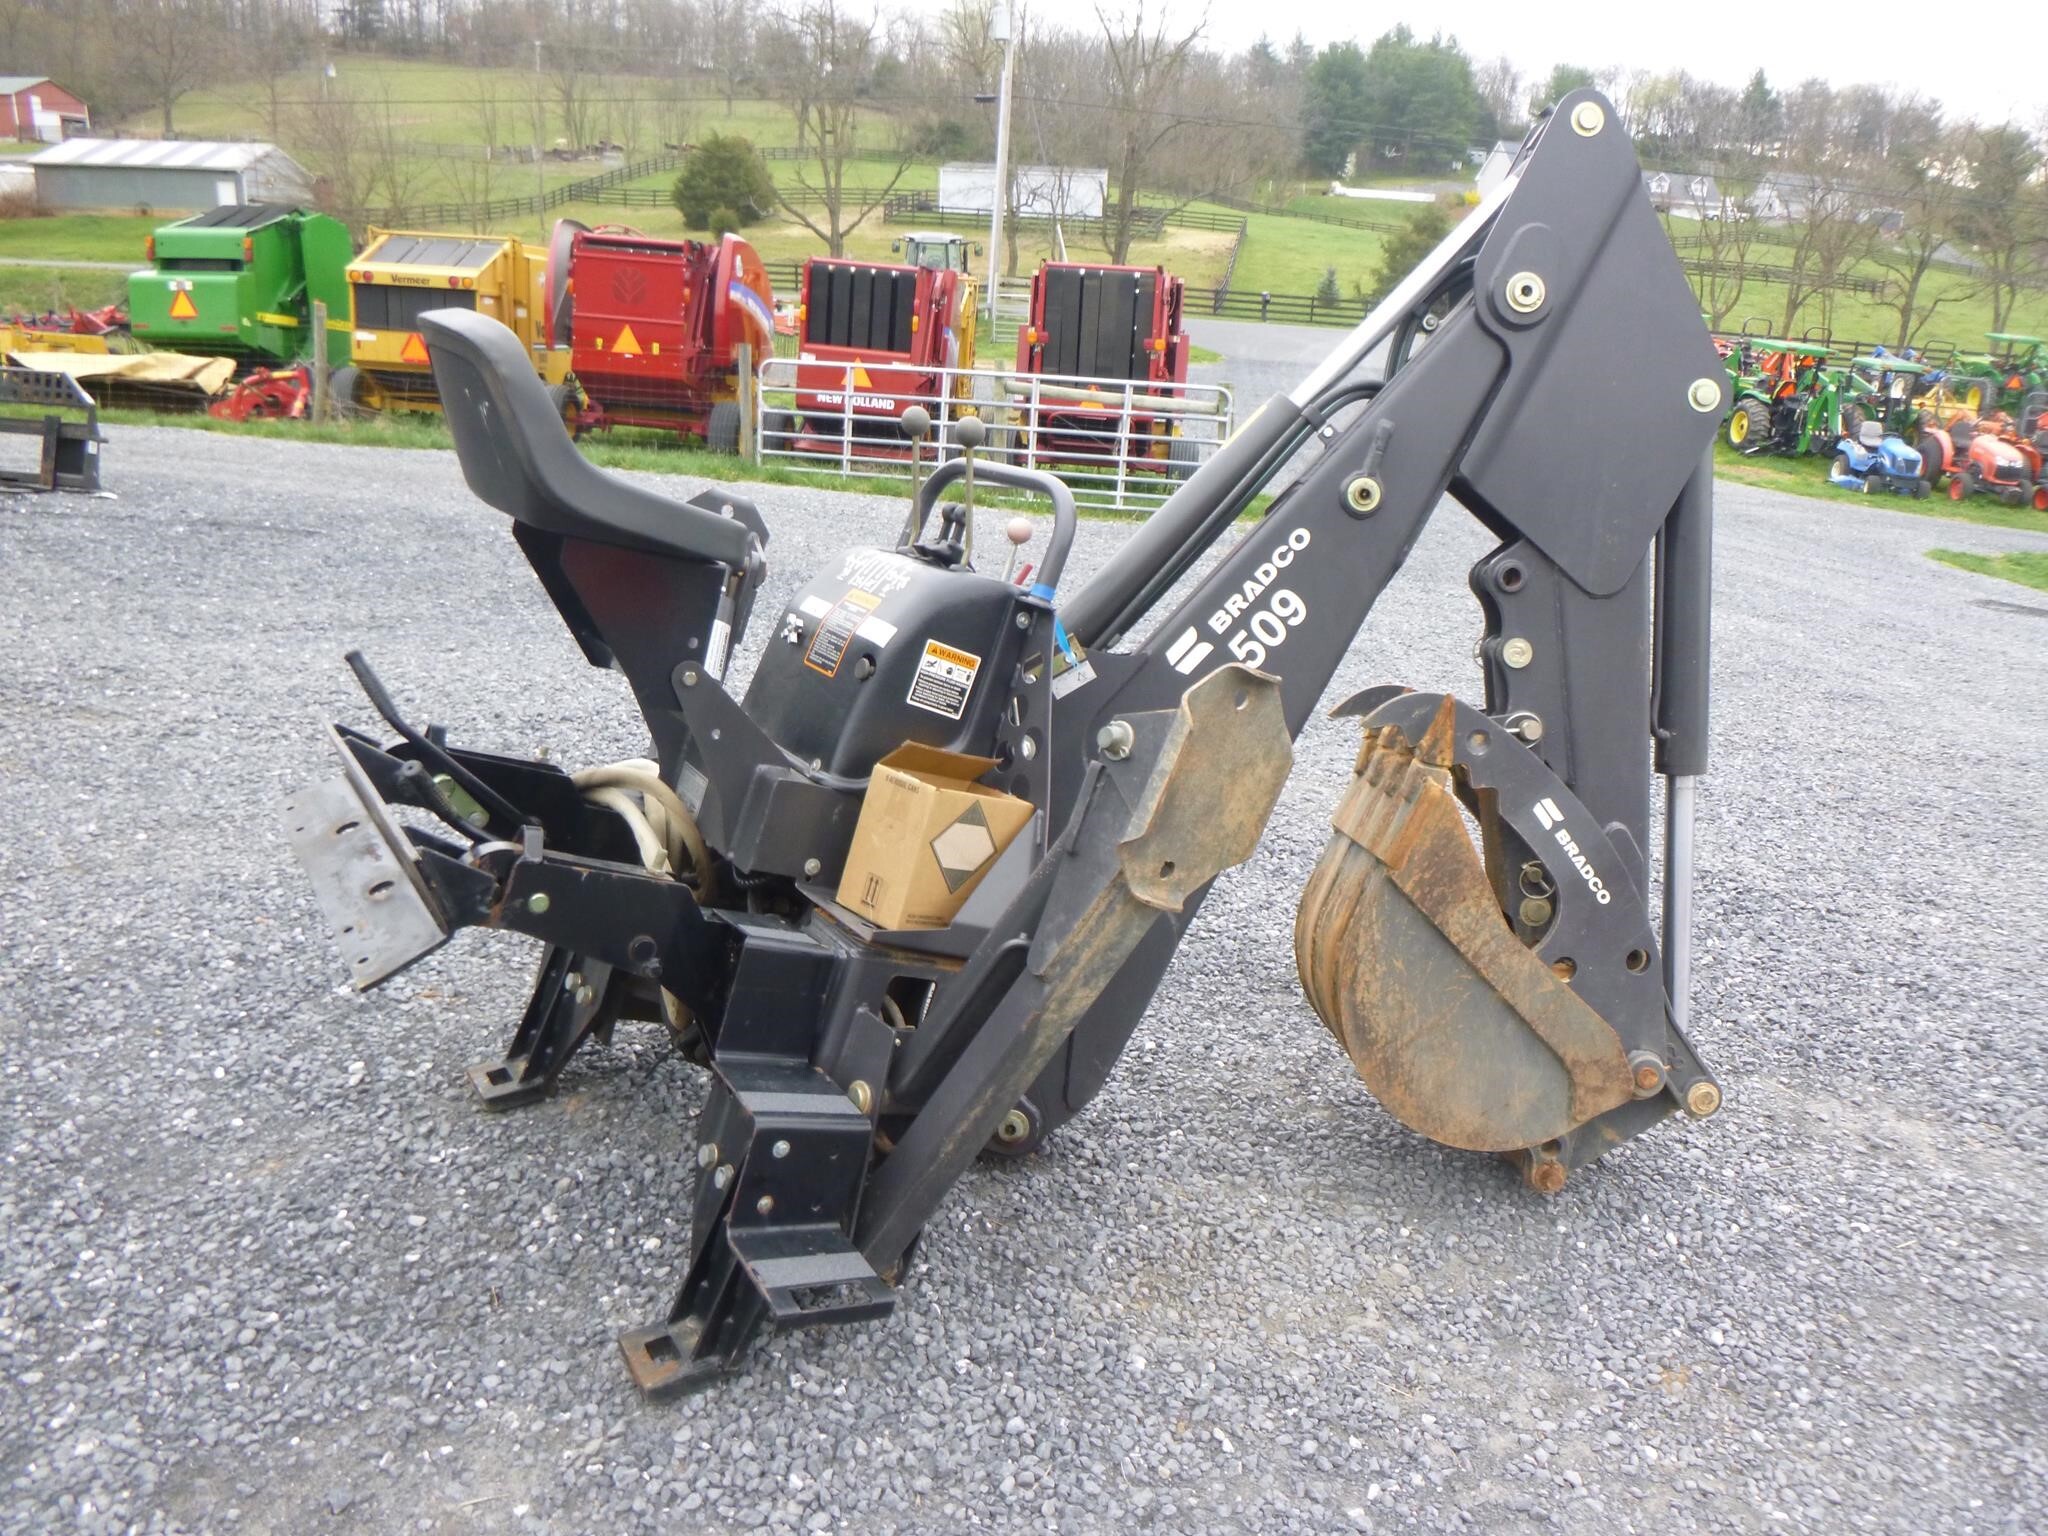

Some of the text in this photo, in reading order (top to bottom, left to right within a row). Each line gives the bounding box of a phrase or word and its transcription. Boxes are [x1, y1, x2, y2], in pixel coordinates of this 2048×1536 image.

[391, 275, 431, 285] Vermeer
[817, 394, 842, 404] NEW
[1207, 527, 1311, 635] BRADCO
[1227, 589, 1307, 669] 509
[939, 649, 975, 668] WARNING
[1554, 828, 1611, 904] BRADCO
